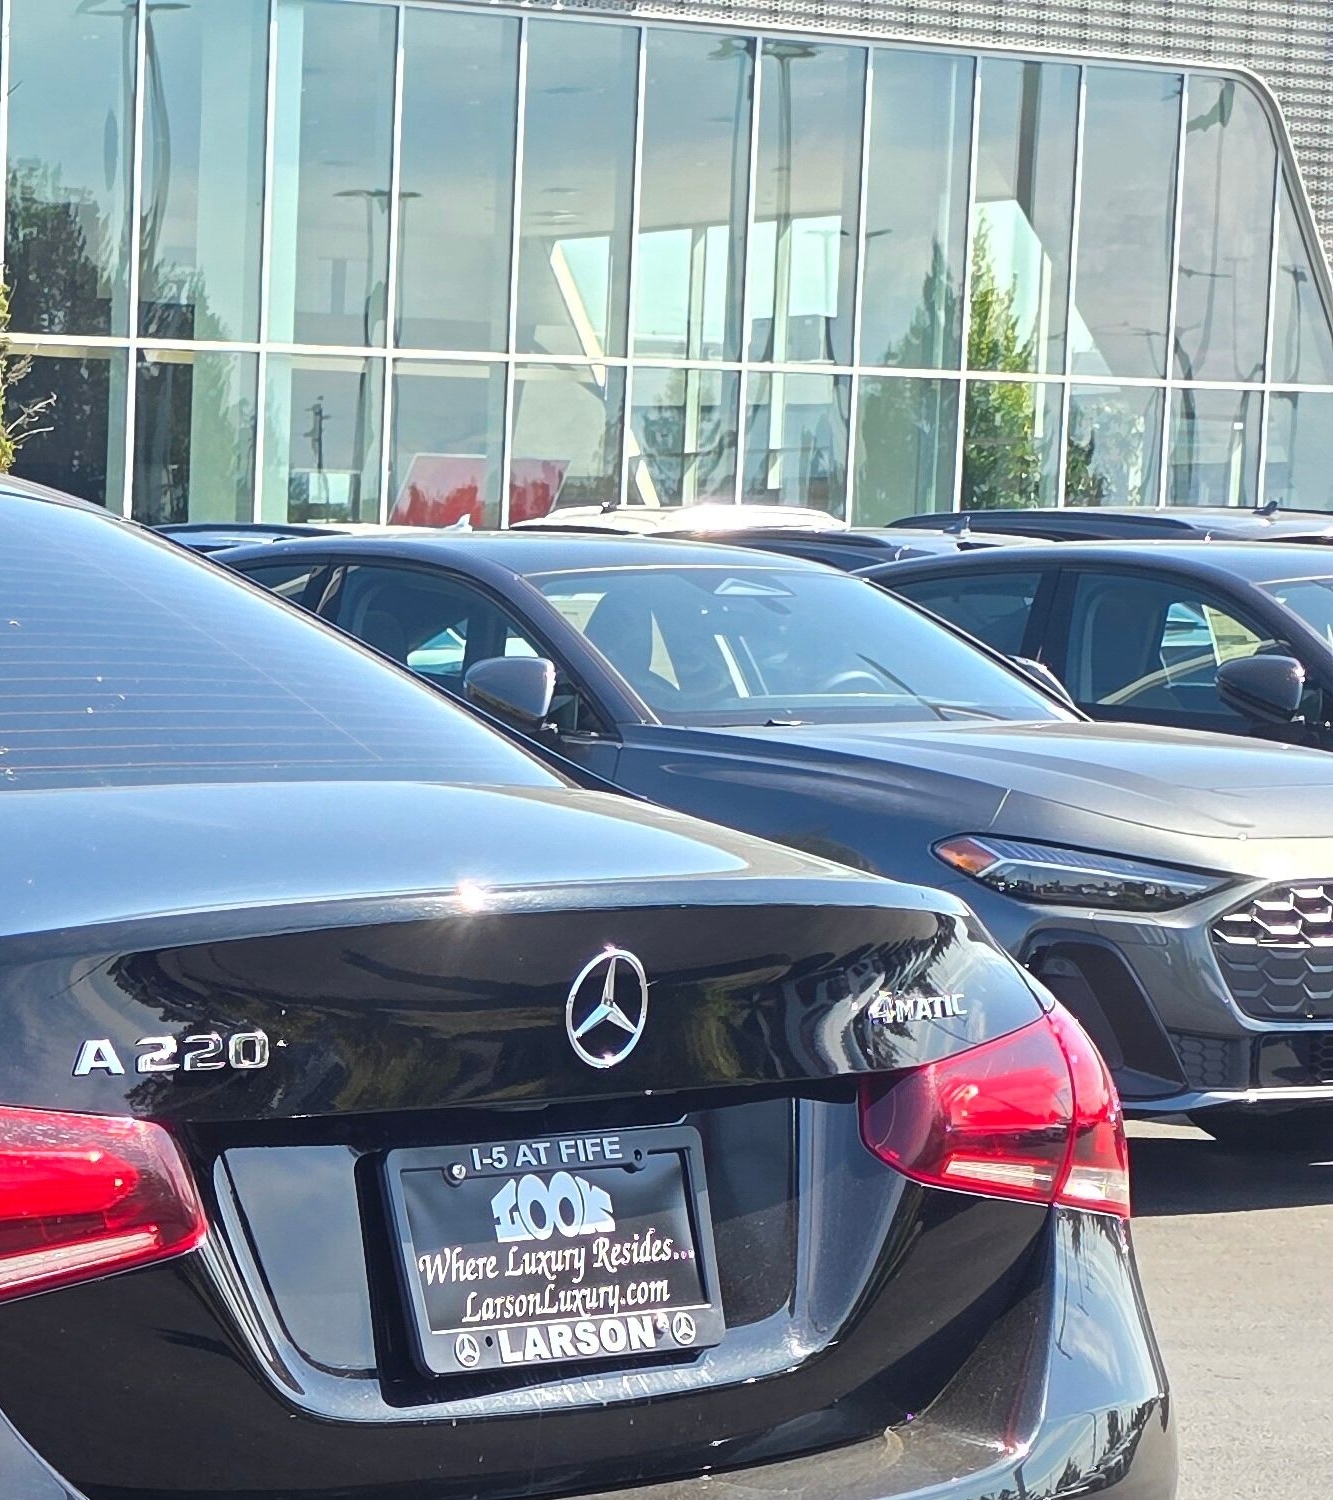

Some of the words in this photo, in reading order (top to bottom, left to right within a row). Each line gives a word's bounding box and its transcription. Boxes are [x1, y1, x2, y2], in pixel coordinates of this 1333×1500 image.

[868, 990, 968, 1024] 4MATIC
[73, 1038, 125, 1076] A
[134, 1031, 270, 1074] 220
[471, 1144, 508, 1171] I-5
[515, 1141, 551, 1168] AT
[560, 1136, 623, 1164] FIFE
[418, 1246, 500, 1285] Where
[504, 1244, 586, 1283] Luxury
[592, 1227, 695, 1273] Resides...
[461, 1276, 671, 1324] LarsonLuxury.com
[496, 1315, 657, 1364] LARSON
